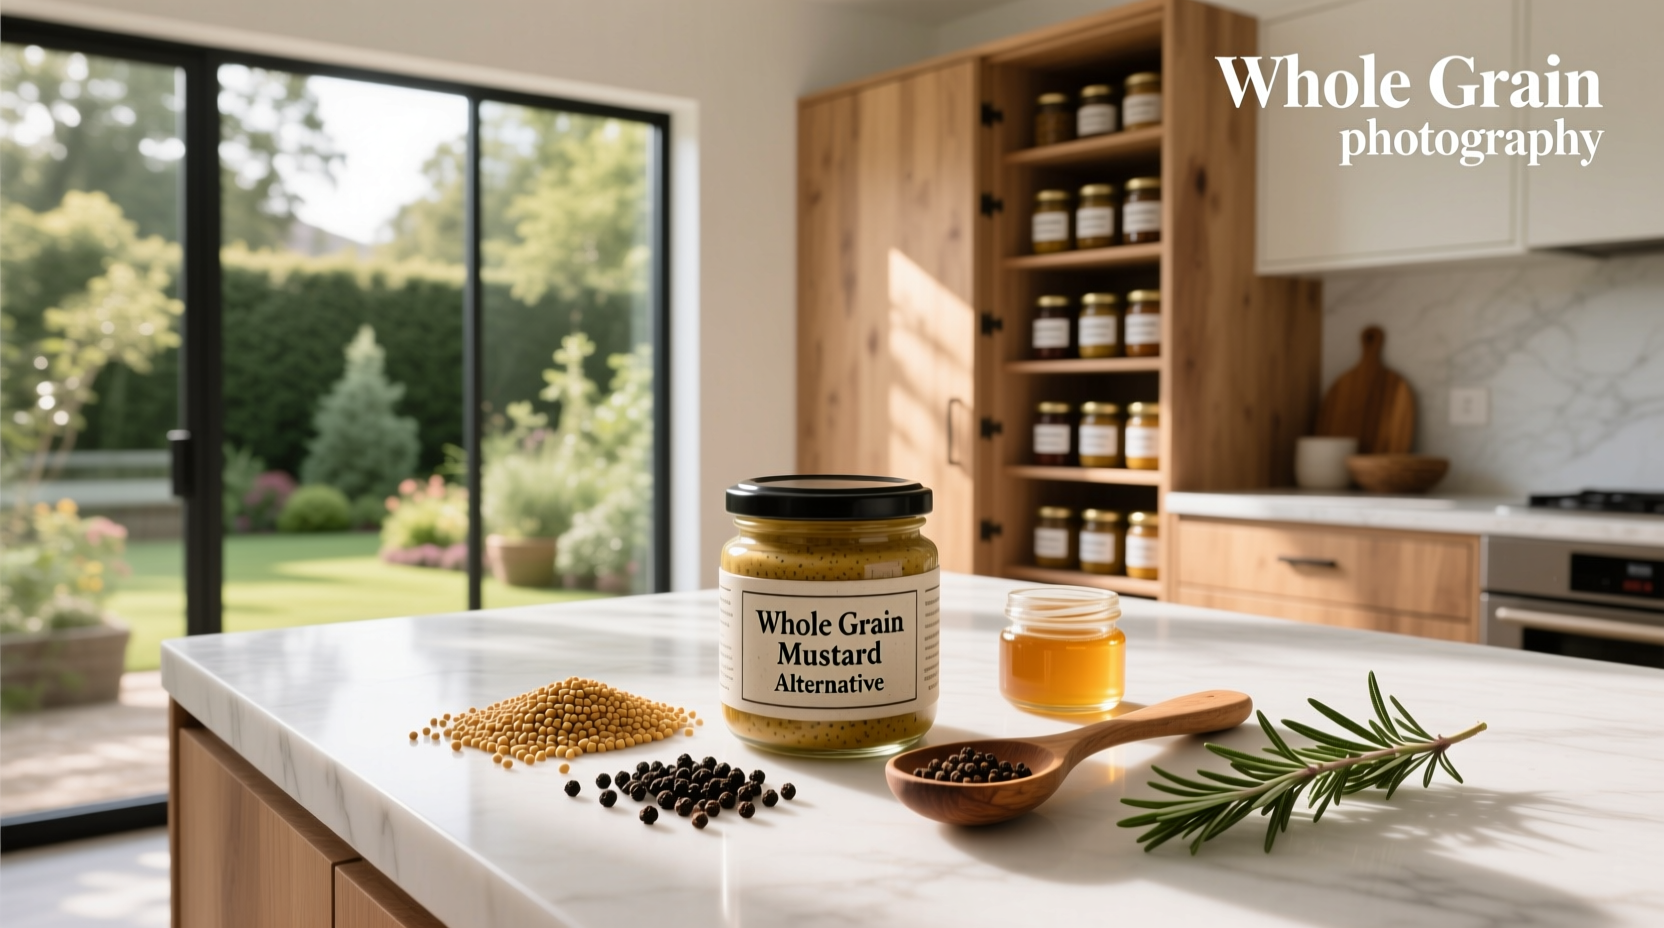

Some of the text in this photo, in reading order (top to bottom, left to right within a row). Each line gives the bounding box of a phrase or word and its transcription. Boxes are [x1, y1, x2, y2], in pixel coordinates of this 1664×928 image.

[756, 610, 904, 636] Whole Grain
[777, 640, 882, 666] Mustard
[774, 673, 884, 694] Alternative
